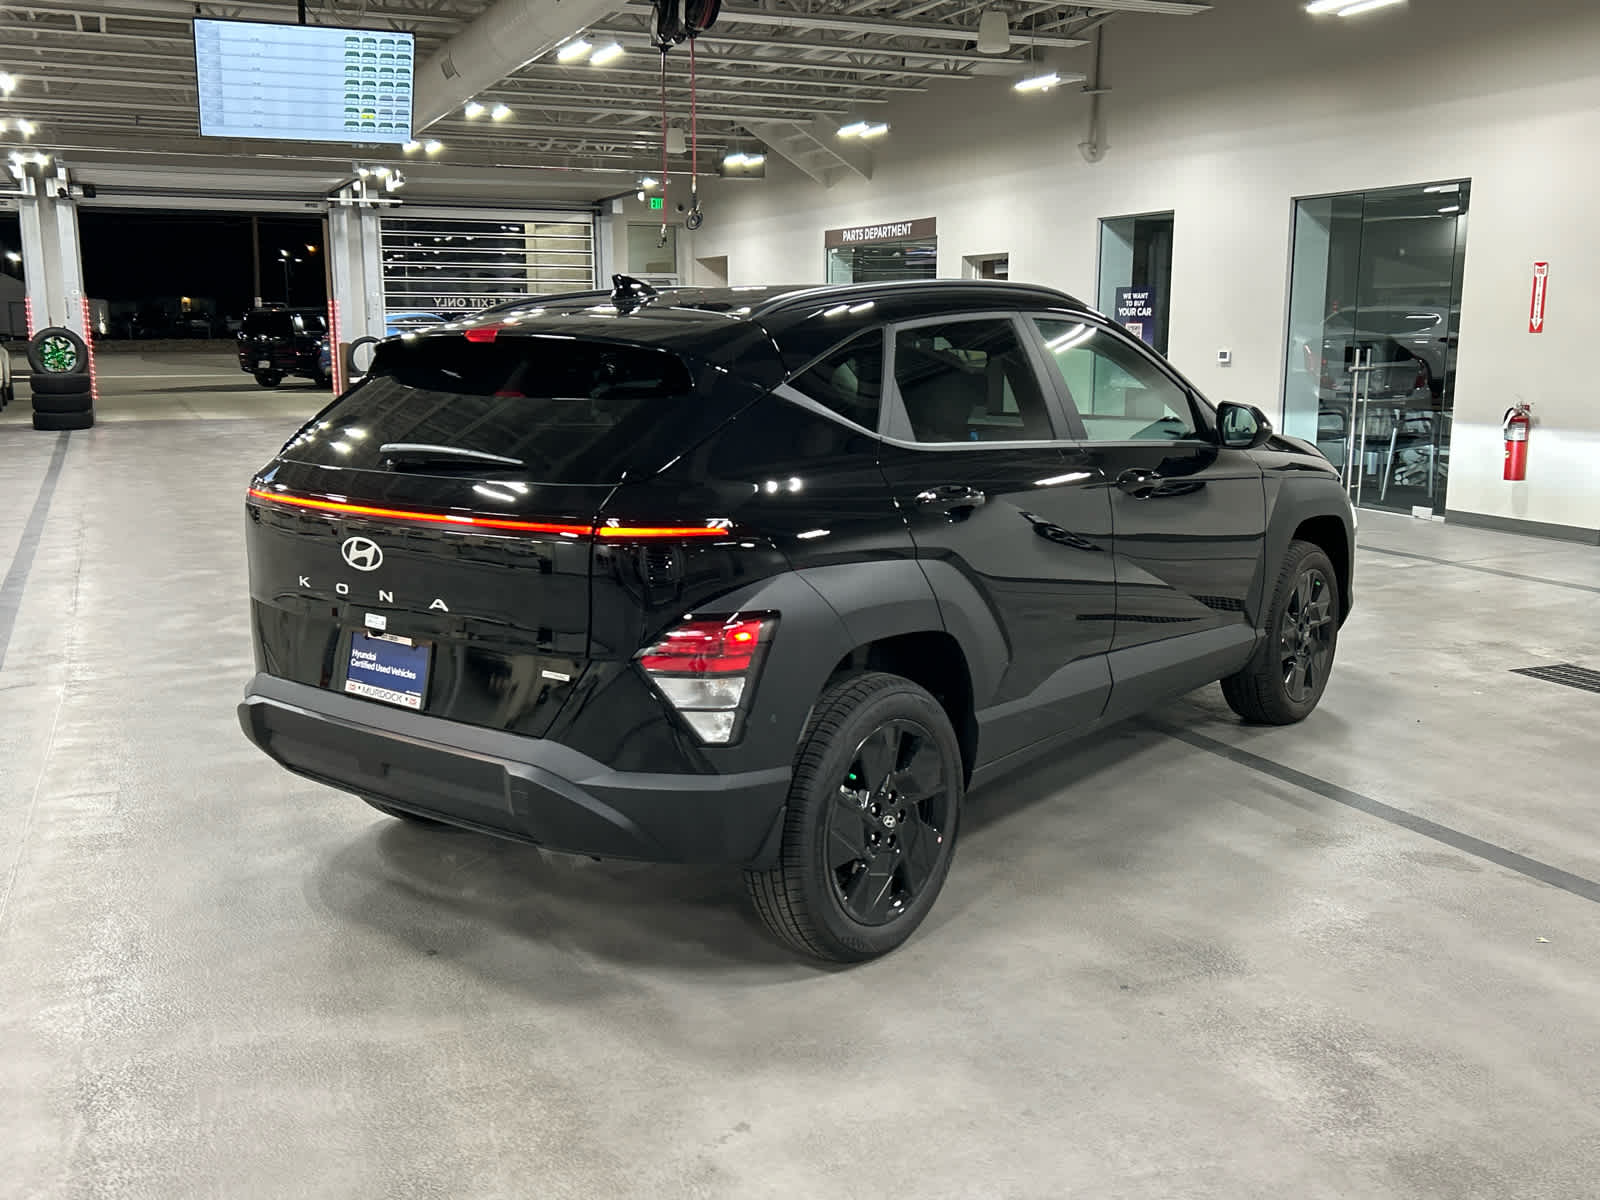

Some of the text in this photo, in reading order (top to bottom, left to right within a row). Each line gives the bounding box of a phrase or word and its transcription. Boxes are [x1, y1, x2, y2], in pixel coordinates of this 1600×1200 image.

[842, 223, 913, 242] PARTS DEPARTMENT
[1122, 292, 1149, 300] WE WANT
[1119, 307, 1152, 316] YOUR CAR
[299, 575, 449, 612] KONA
[352, 648, 377, 661] Hyundai
[351, 658, 417, 680] Certified Used Vehicles
[361, 686, 403, 704] MURDOCK
